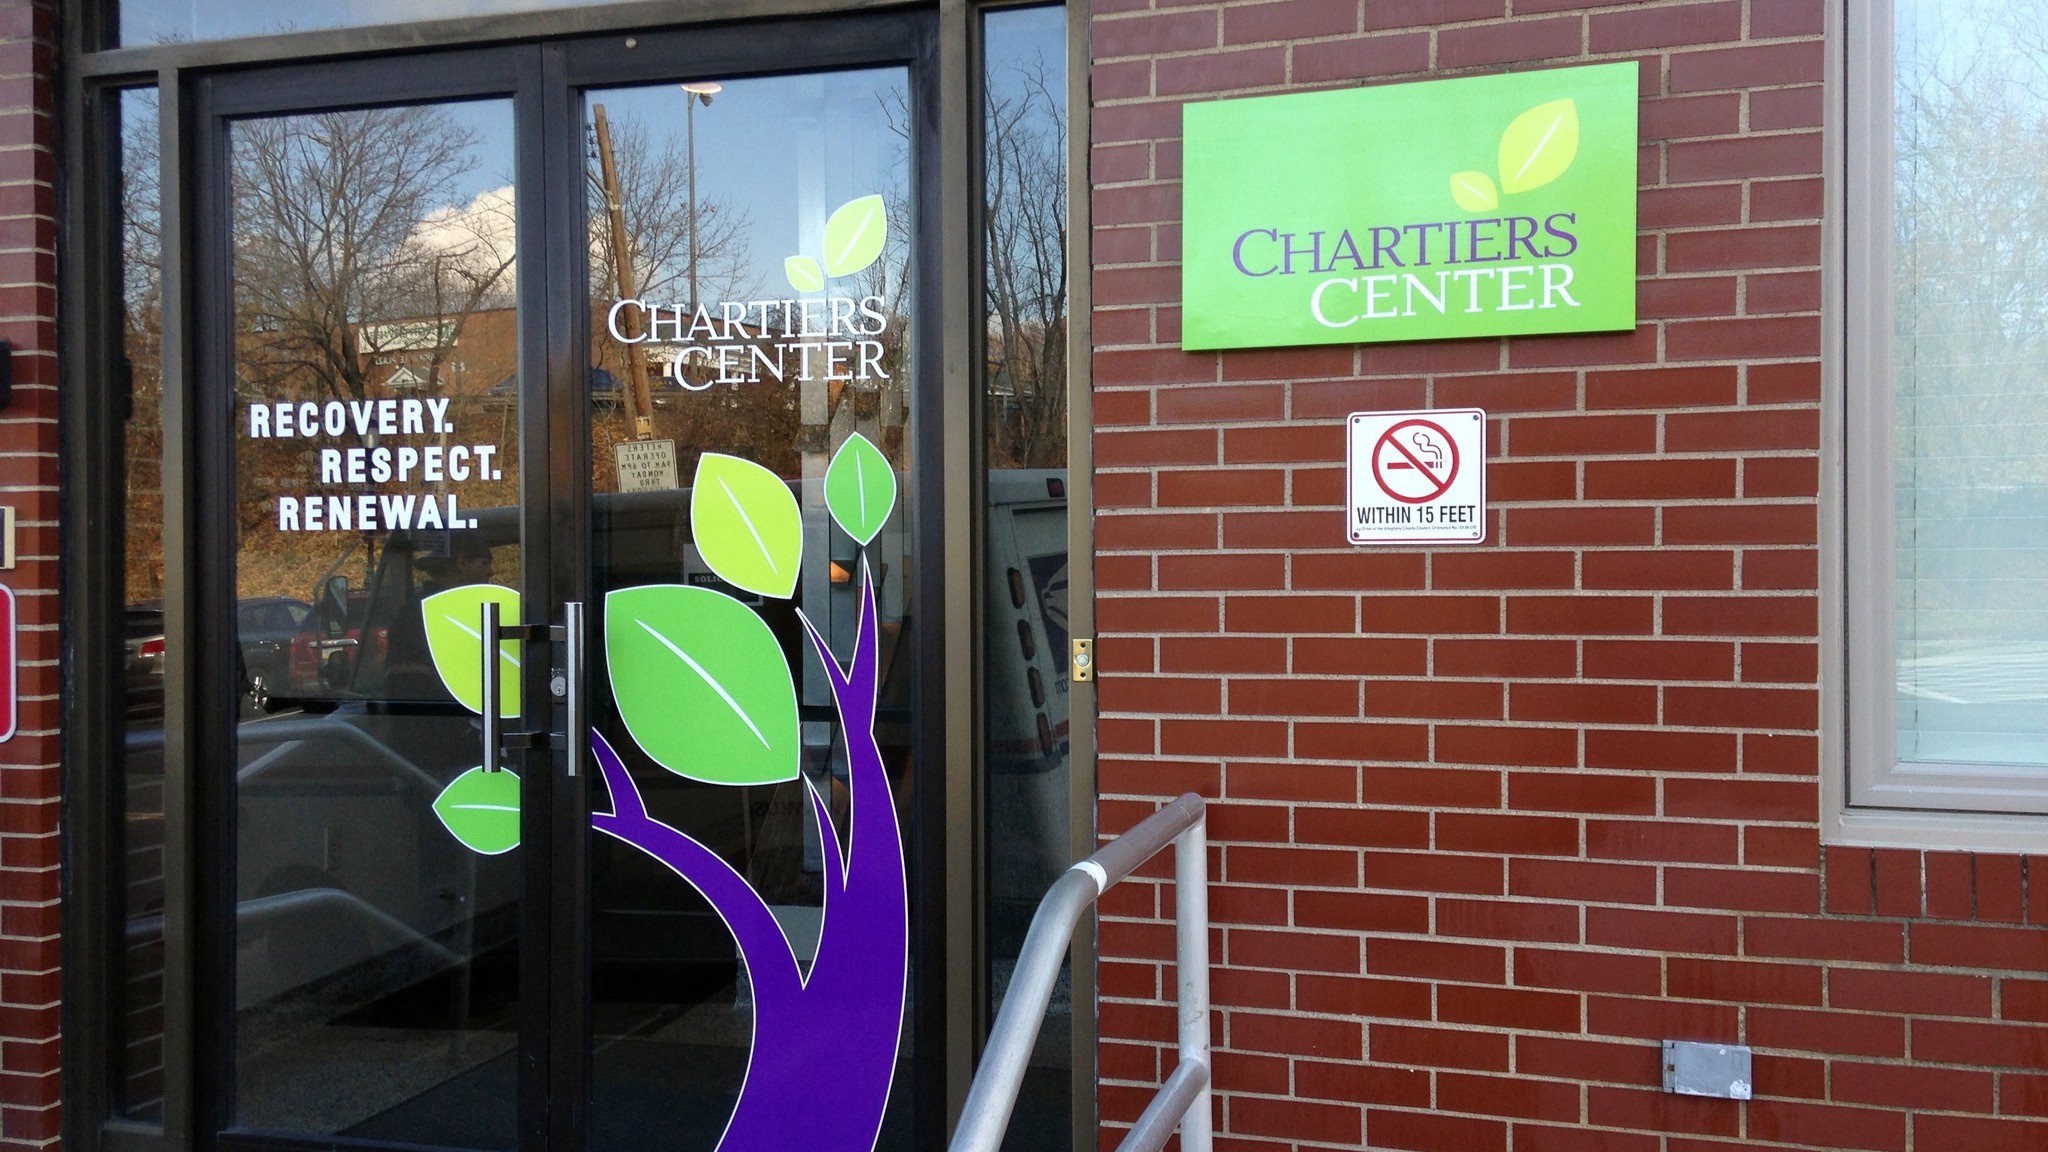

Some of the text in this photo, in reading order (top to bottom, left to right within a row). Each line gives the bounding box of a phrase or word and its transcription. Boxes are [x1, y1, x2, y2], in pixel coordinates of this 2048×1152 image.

[1232, 212, 1578, 278] CHARTIERS
[1310, 263, 1581, 328] CENTER
[608, 296, 887, 344] CHARTIERS
[673, 340, 890, 391] CENTER
[250, 397, 454, 439] RECOVERY.
[321, 445, 502, 484] RESPECT.
[279, 494, 478, 531] RENEWAL.
[1357, 505, 1476, 524] WITHIN 15 FEET
[694, 575, 723, 583] SOLIC
